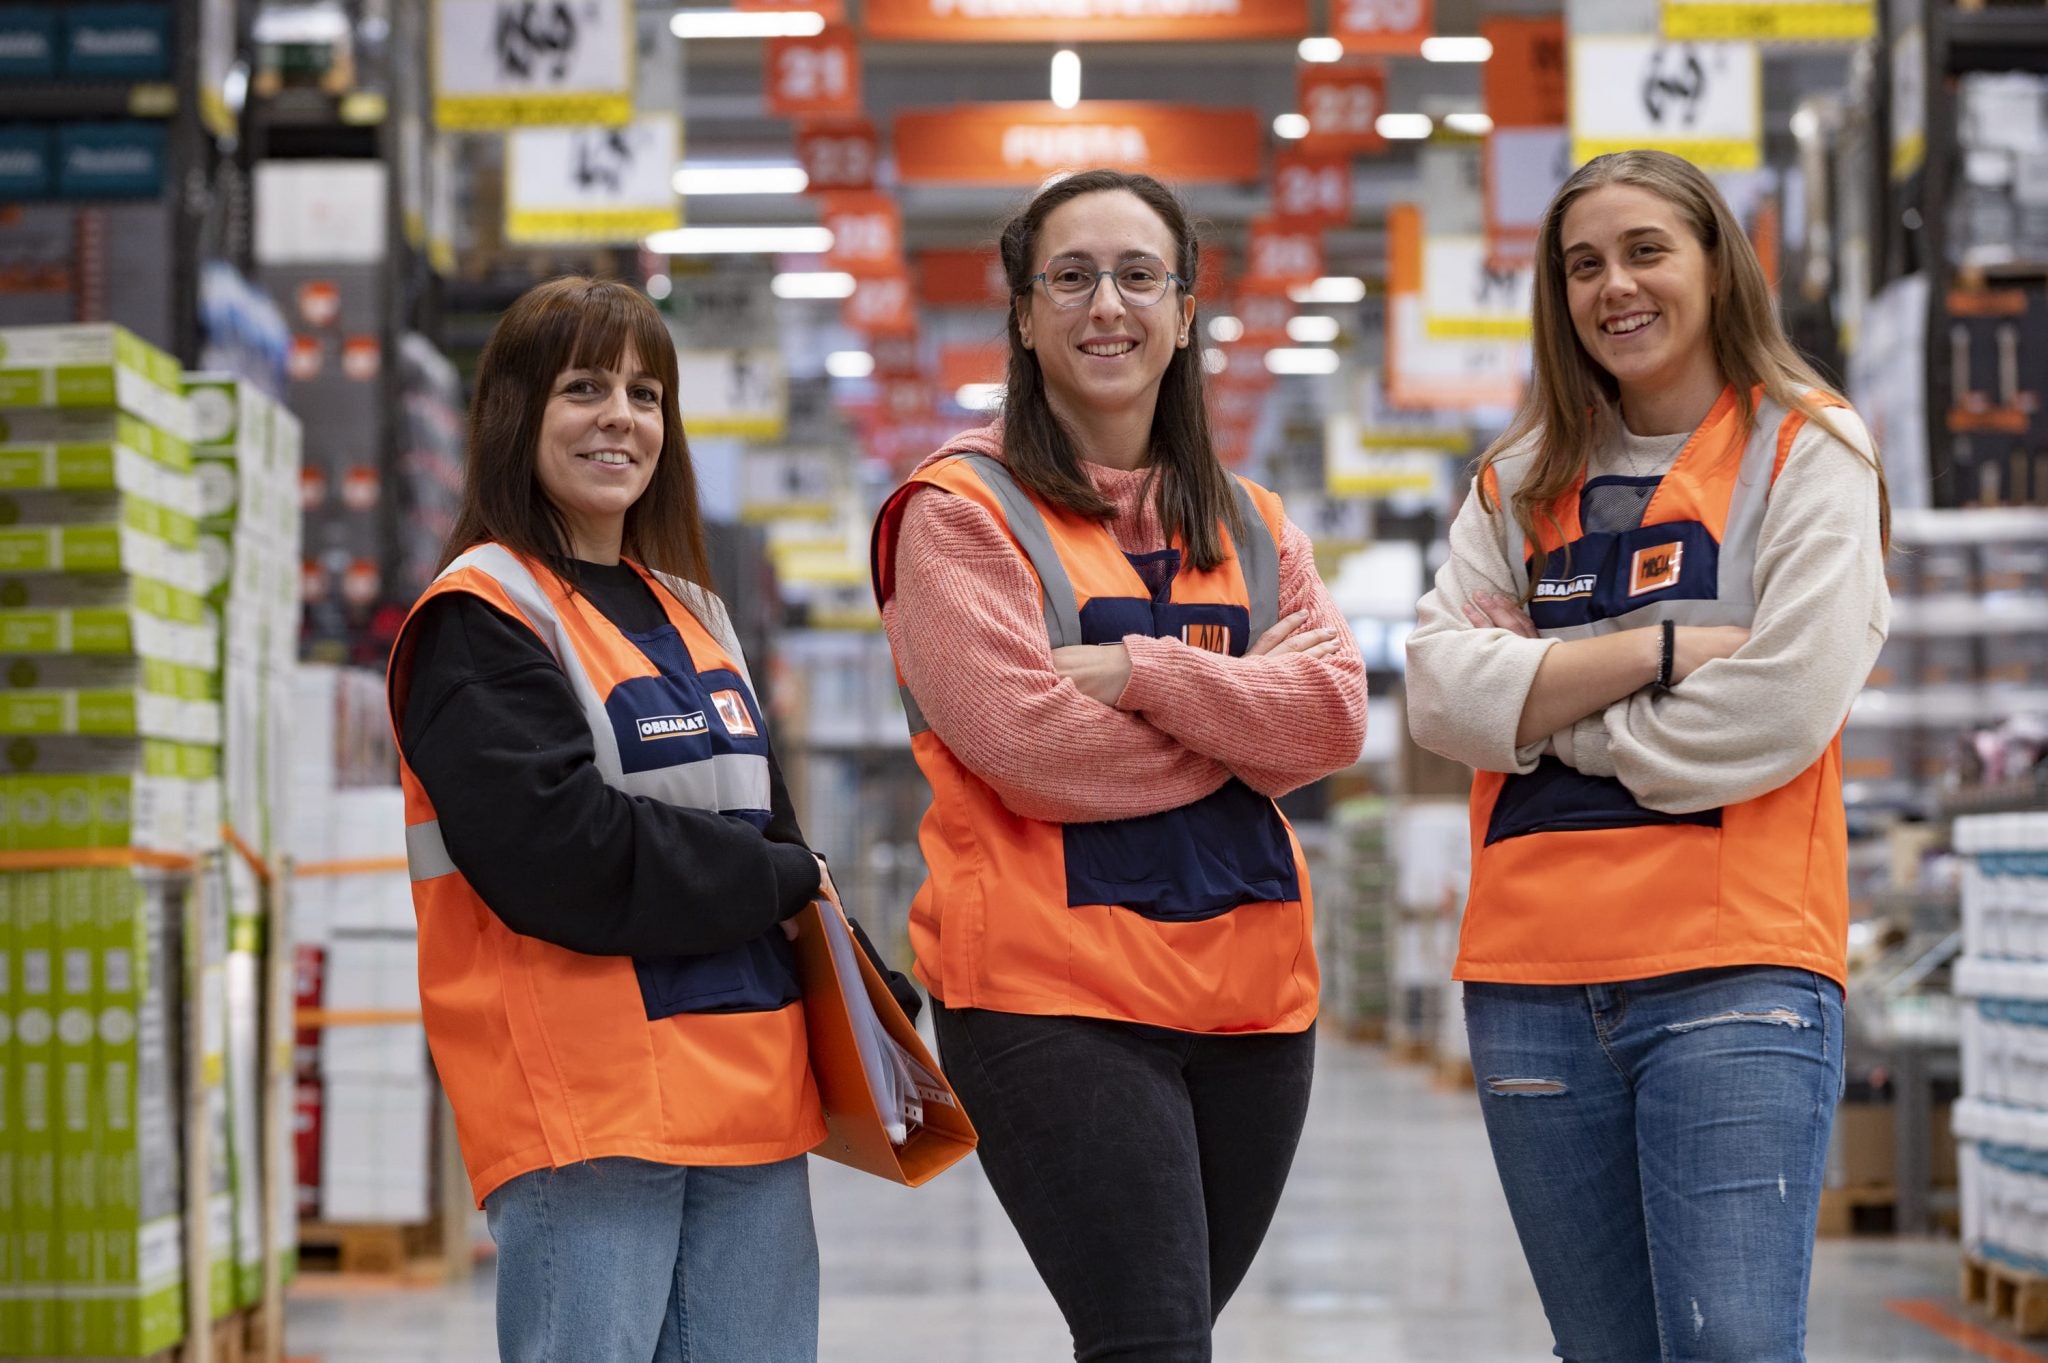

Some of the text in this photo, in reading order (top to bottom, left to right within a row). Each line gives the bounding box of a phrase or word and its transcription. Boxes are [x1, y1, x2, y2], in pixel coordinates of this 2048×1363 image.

[779, 46, 847, 98] 21
[1278, 165, 1344, 214] 24
[1534, 578, 1594, 597] BRAMAT
[641, 715, 705, 736] OBRAMAT
